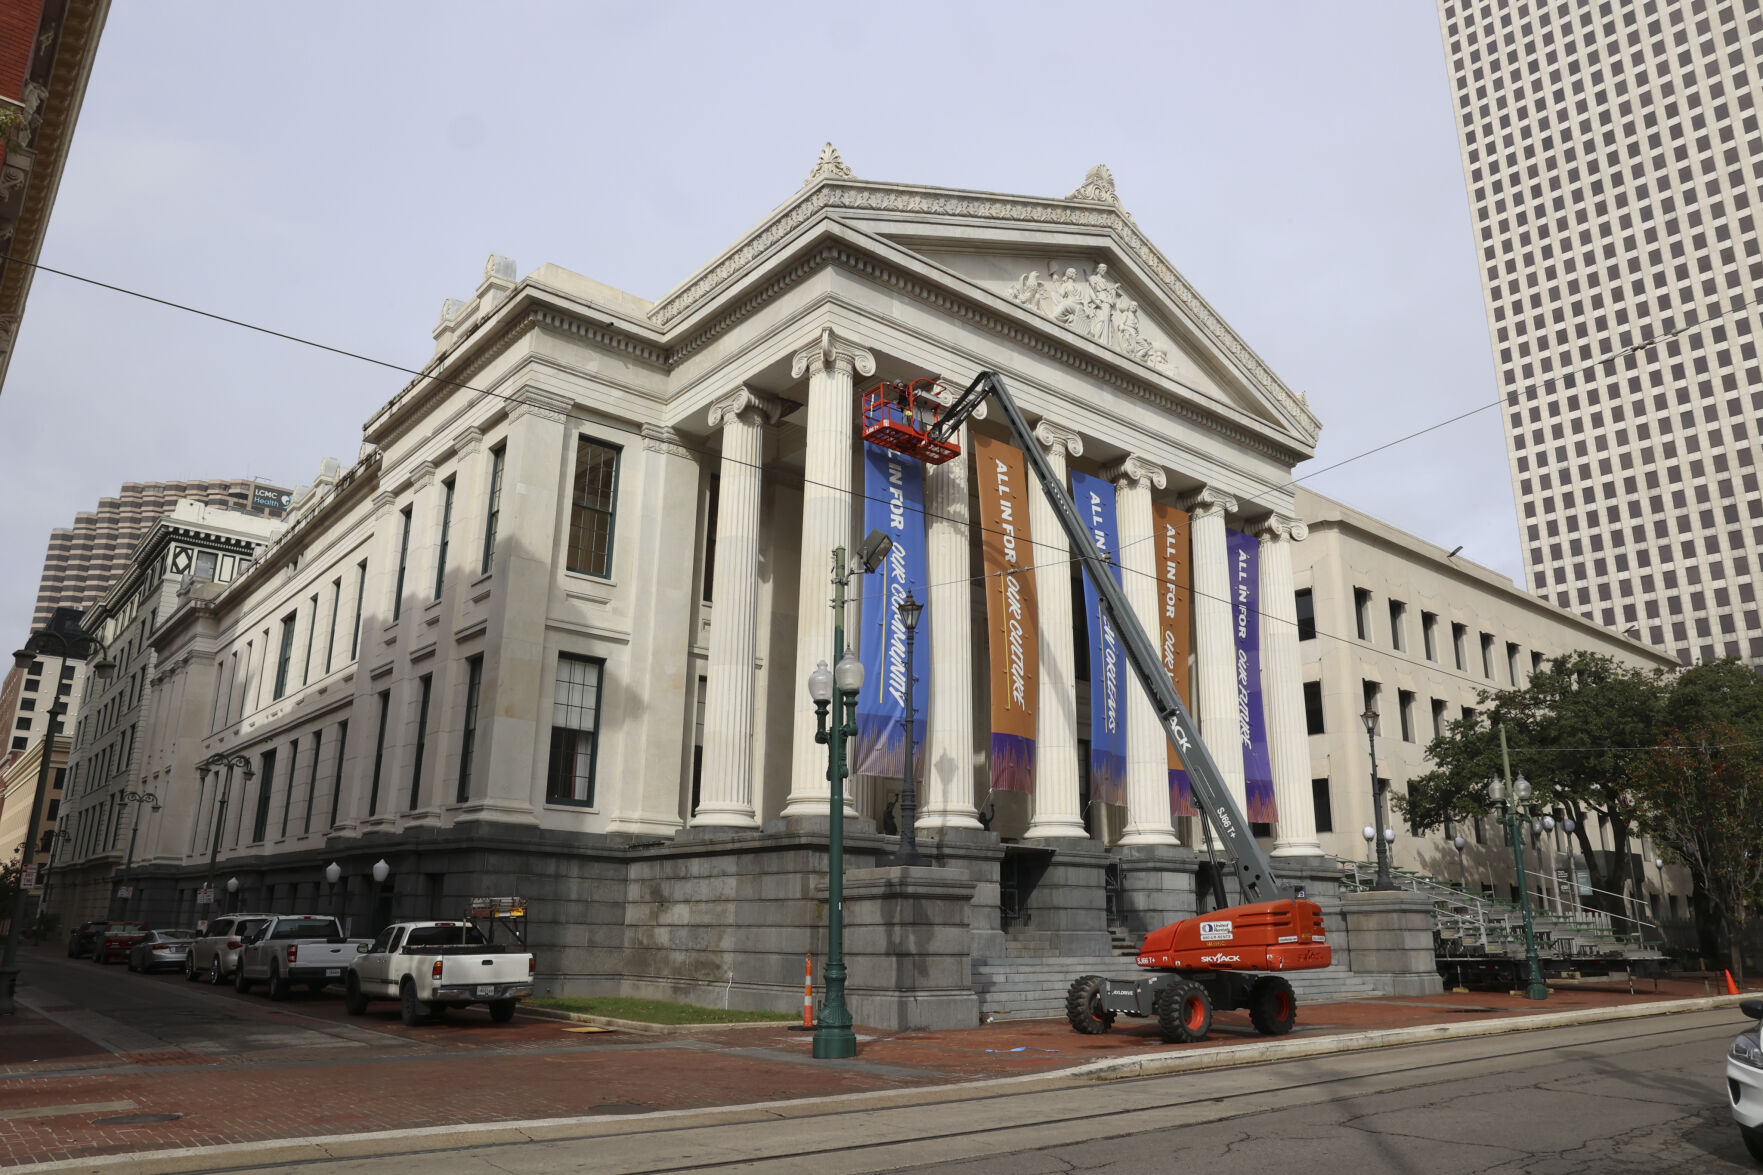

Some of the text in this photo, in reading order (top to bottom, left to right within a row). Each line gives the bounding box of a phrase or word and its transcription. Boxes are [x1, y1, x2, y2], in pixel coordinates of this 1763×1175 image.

[888, 462, 903, 485] IN
[254, 496, 279, 507] Health
[255, 489, 278, 499] LCMC
[889, 487, 904, 530] FOR
[1089, 490, 1103, 527] ALL
[1094, 528, 1107, 550] IN
[1166, 523, 1176, 558] ALL
[890, 541, 906, 584] OUR
[1166, 560, 1176, 580] IN
[995, 458, 1025, 711] ALL IN FOR OUR CULTURE
[1166, 582, 1176, 619] FOR
[889, 583, 907, 708] COMMUNITY
[1164, 630, 1175, 669] OUR
[1237, 548, 1252, 750] ALL IN FOR OUR FUTURE
[1105, 648, 1117, 734] ORLEANS
[1168, 715, 1192, 754] ACK
[1217, 806, 1236, 839] SJ66 T+
[1201, 953, 1240, 963] SKYJACK
